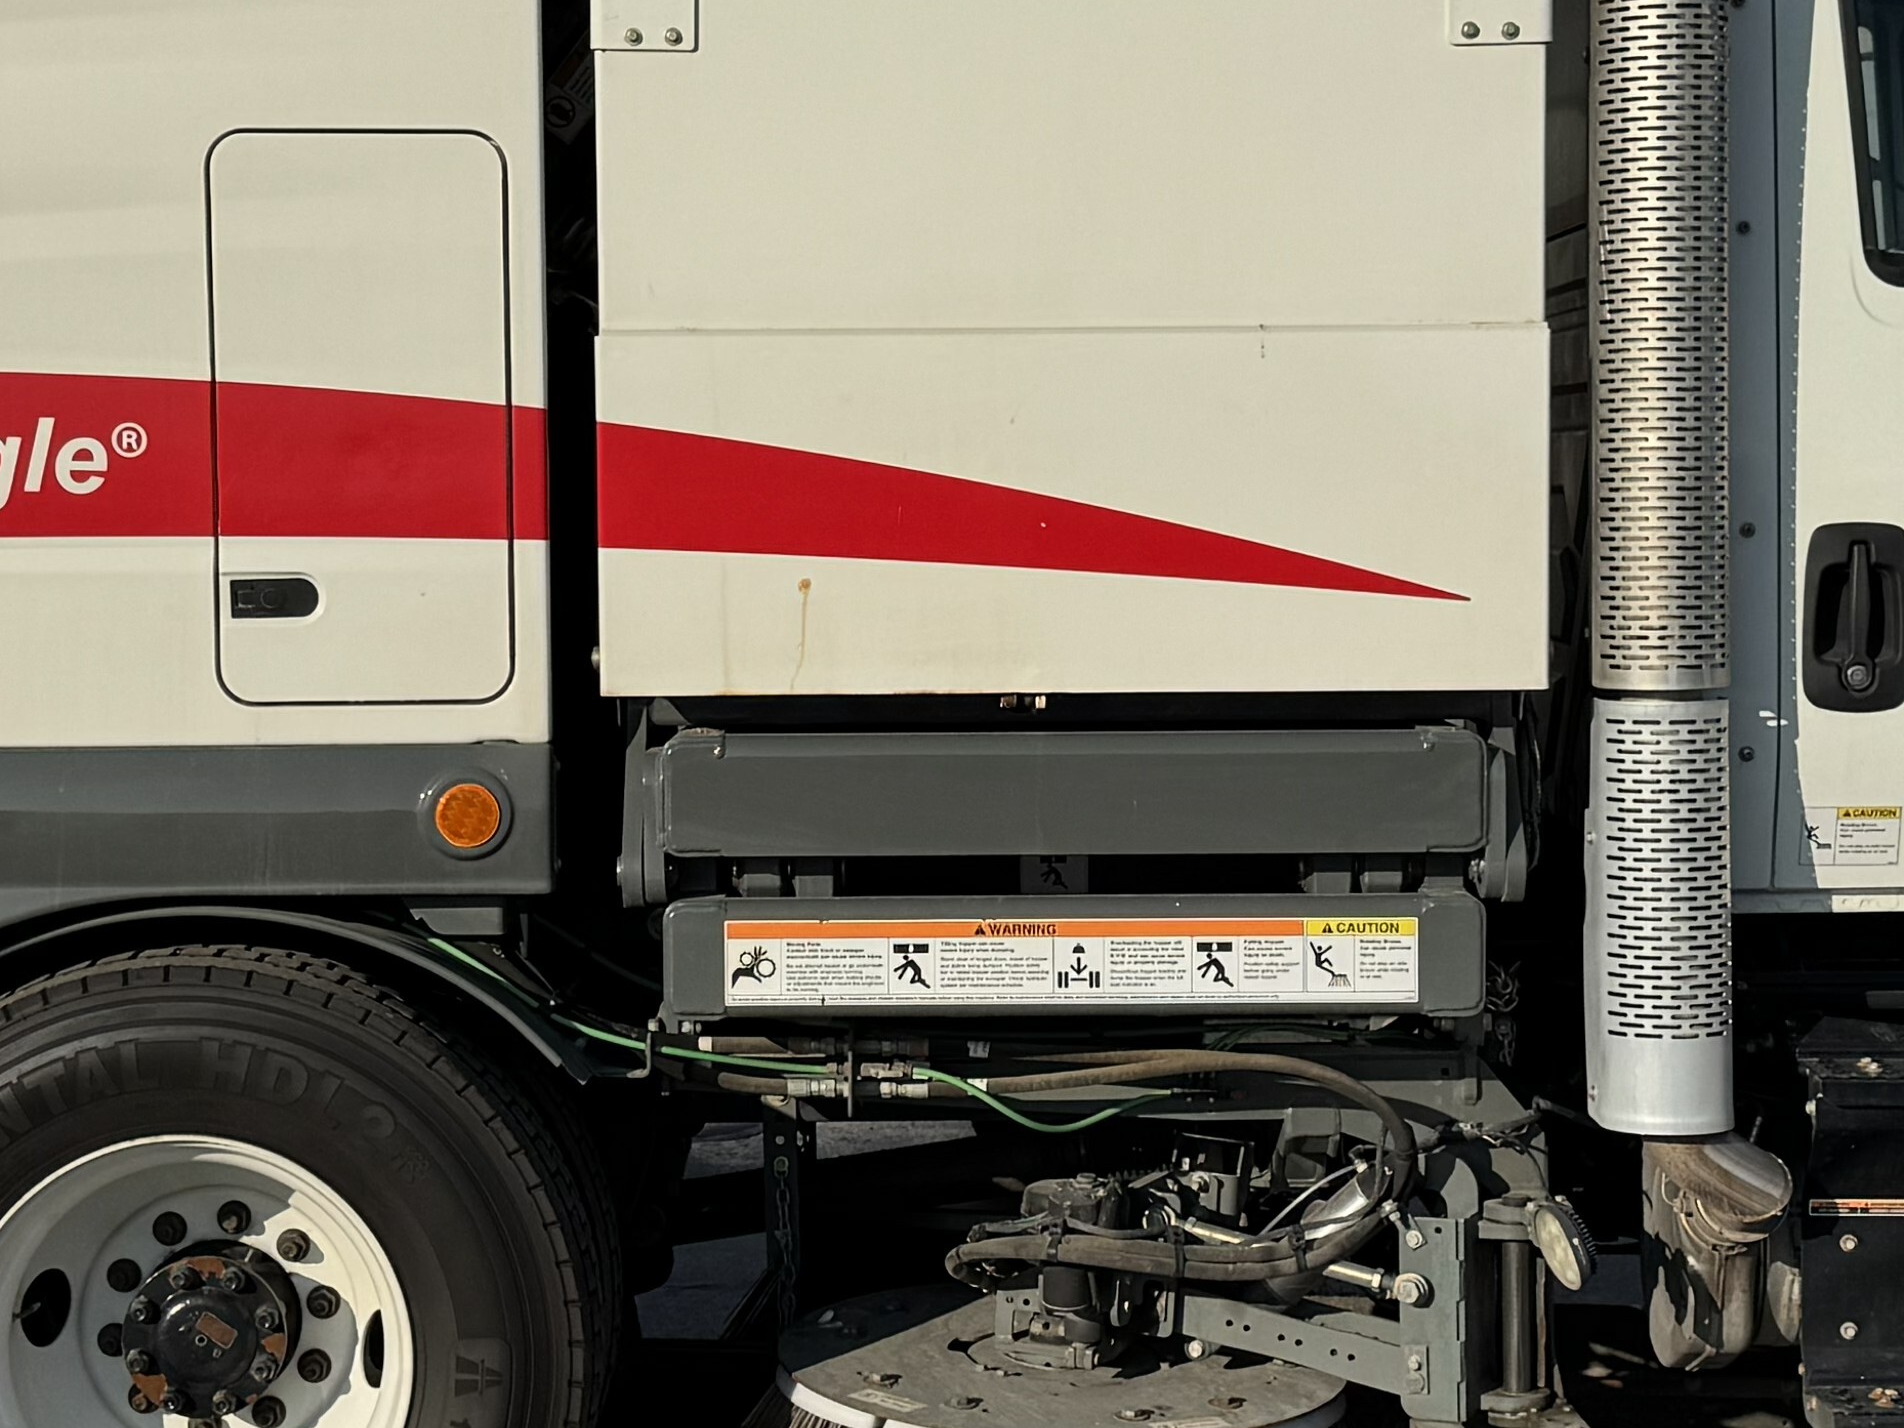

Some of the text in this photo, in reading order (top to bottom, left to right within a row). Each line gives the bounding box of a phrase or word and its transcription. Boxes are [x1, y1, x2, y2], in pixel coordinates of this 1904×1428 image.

[1853, 808, 1897, 818] CAUTION
[987, 923, 1057, 936] WARNING
[1336, 922, 1400, 934] CAUTION
